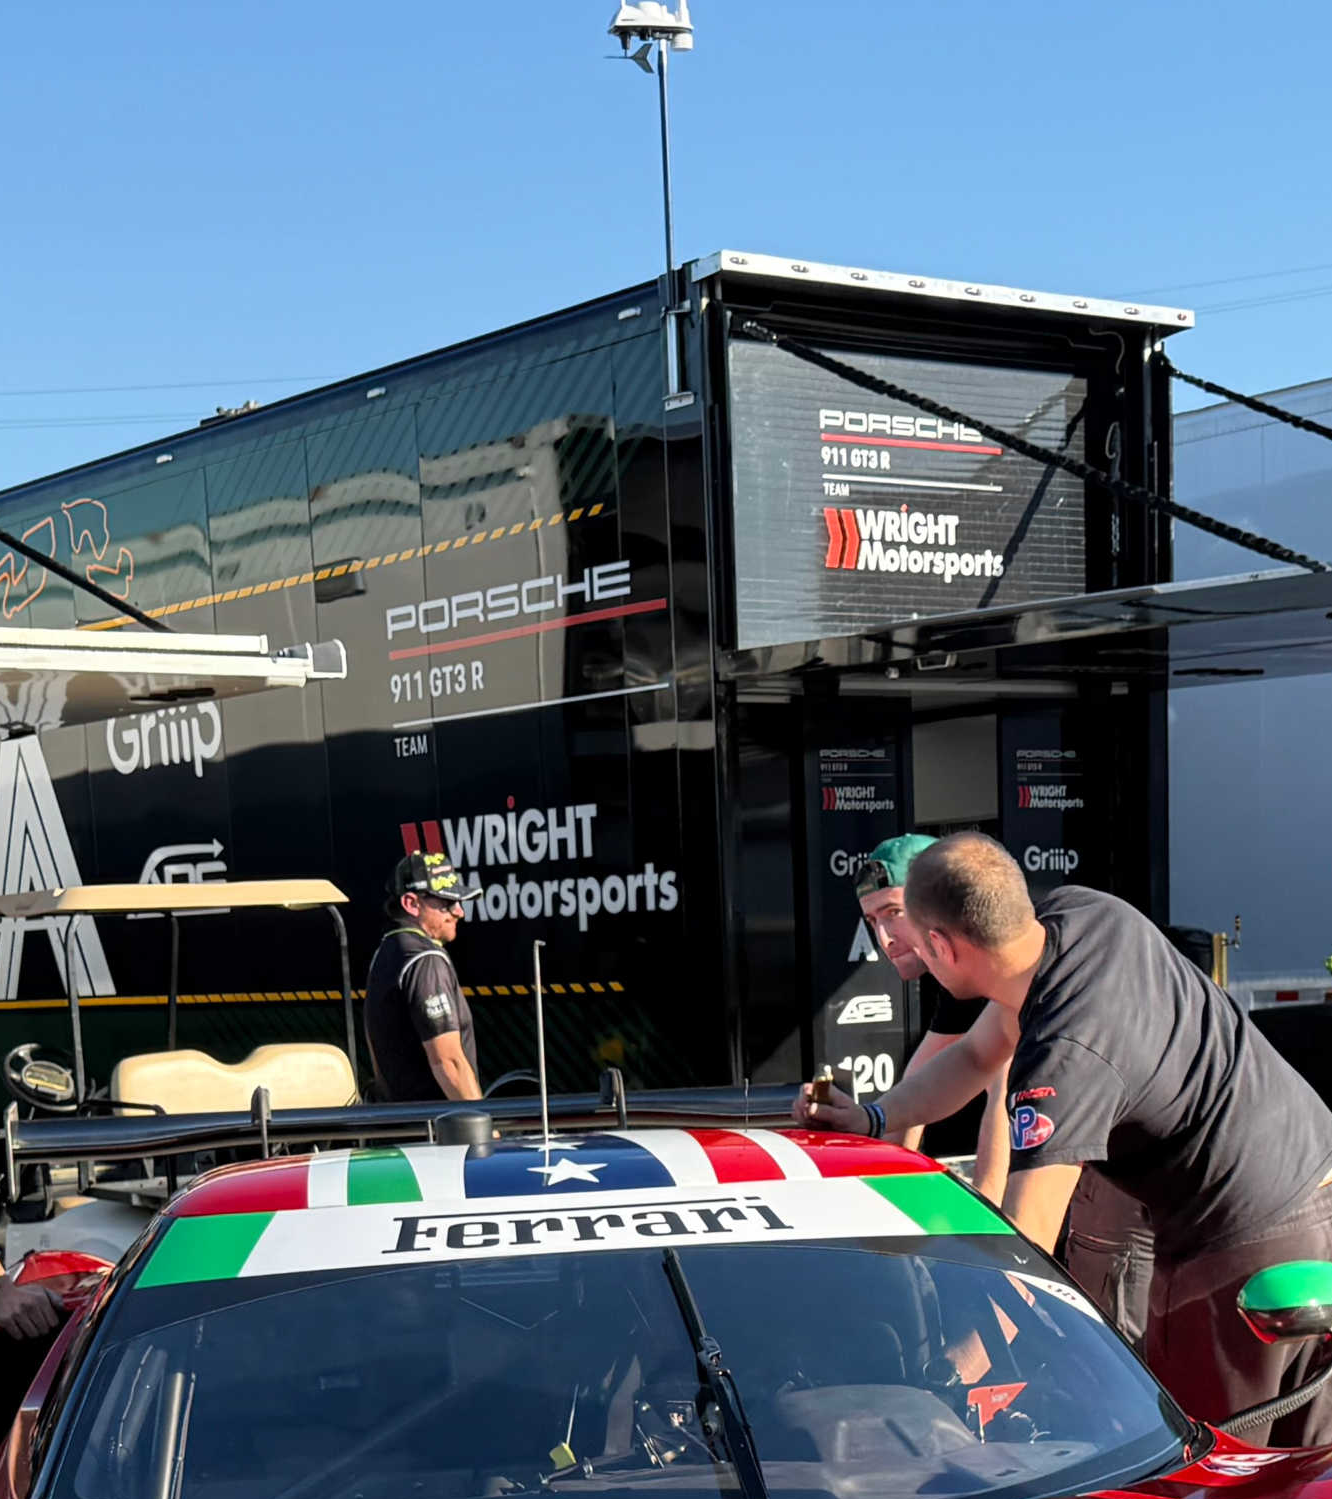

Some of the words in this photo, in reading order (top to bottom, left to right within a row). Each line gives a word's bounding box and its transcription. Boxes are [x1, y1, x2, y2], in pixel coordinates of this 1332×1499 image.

[819, 409, 983, 443] PORSCHE
[821, 446, 848, 467] 911
[850, 448, 878, 469] GT3
[880, 451, 891, 470] R
[823, 483, 850, 497] TEAM
[857, 540, 1005, 584] Motorsports
[386, 560, 631, 640] PORSCHE
[390, 671, 423, 703] 911
[429, 663, 467, 697] GT3
[471, 661, 484, 690] R
[394, 734, 428, 758] TEAM
[835, 786, 875, 799] WRIGHT
[1029, 785, 1067, 797] WRIGHT
[835, 798, 894, 813] Motorsports
[1029, 798, 1084, 812] Motorsports
[1024, 845, 1079, 875] Griiip
[458, 862, 679, 932] Motorsports
[381, 1196, 795, 1254] Ferrari
